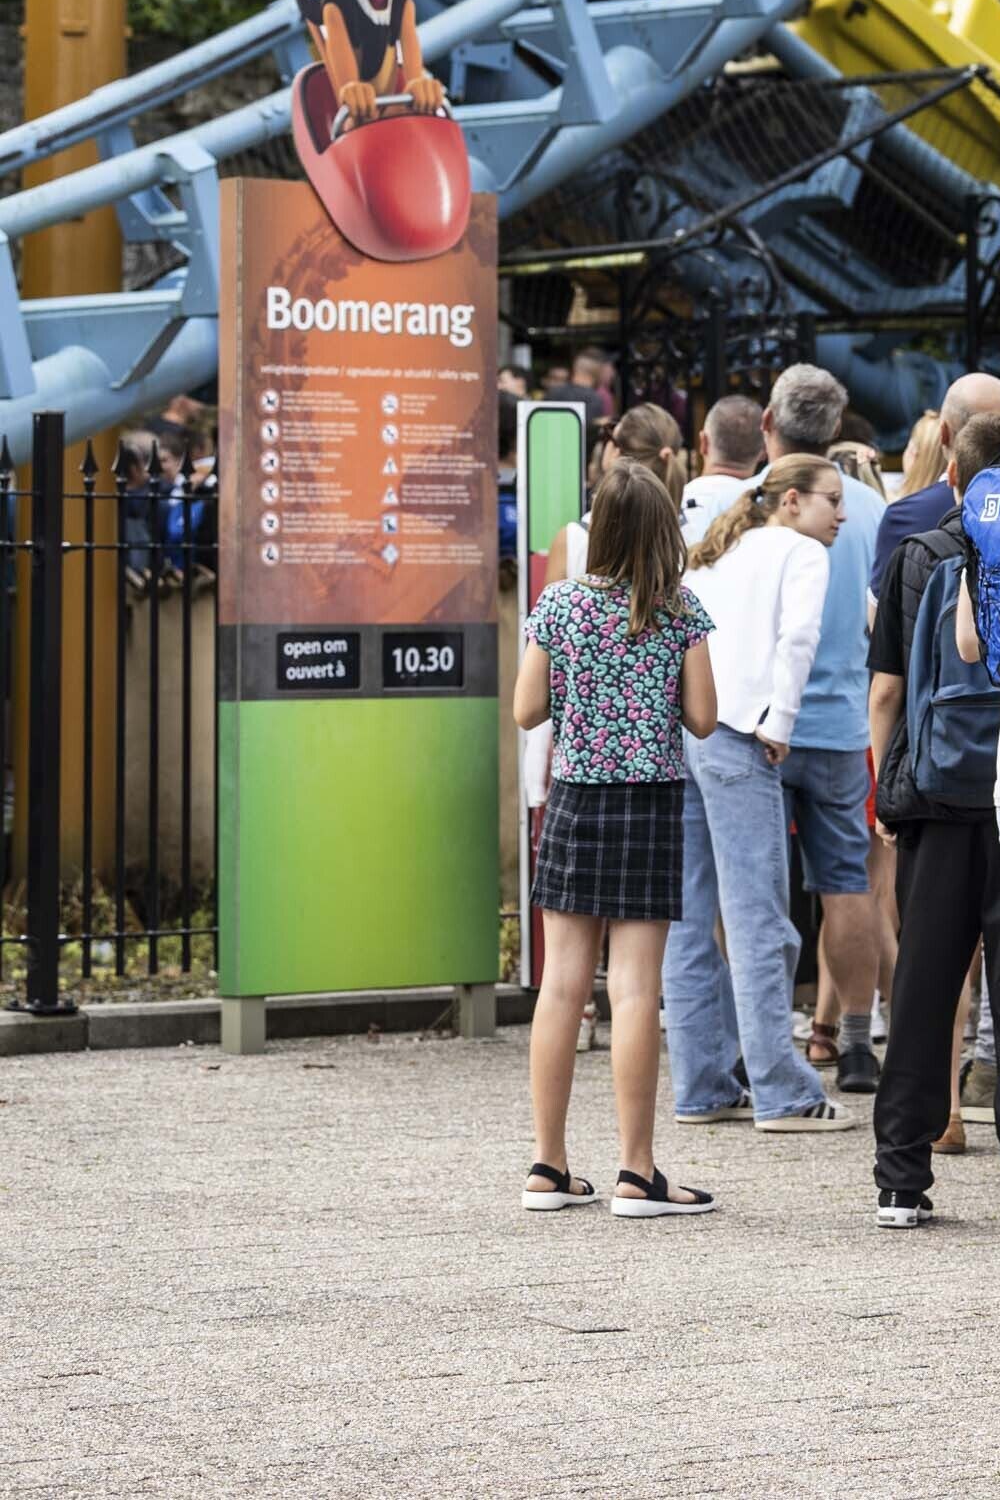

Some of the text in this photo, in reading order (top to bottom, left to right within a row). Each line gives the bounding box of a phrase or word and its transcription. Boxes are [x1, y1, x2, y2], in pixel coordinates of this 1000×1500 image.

[267, 286, 475, 347] Boomerang
[283, 639, 348, 659] open om
[392, 646, 455, 673] 10.30
[286, 660, 346, 680] ouvert à
